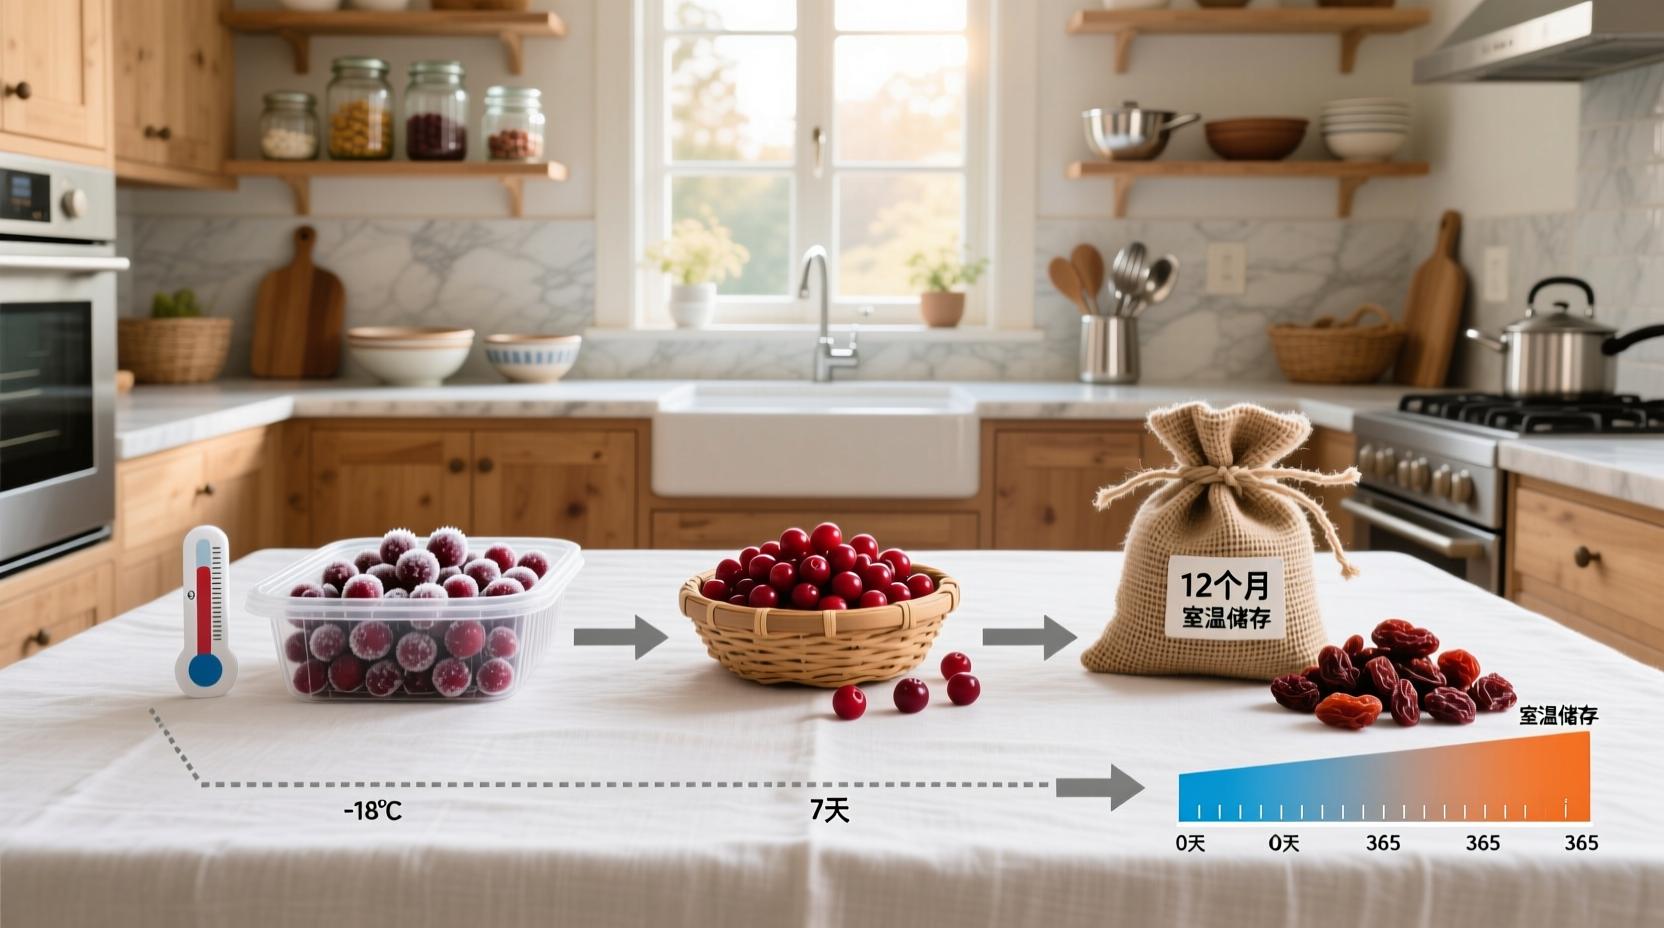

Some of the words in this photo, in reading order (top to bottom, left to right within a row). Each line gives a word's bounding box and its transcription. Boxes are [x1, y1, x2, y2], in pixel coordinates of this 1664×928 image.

[1181, 569, 1268, 601] 12个月
[1182, 605, 1272, 630] 室温储存
